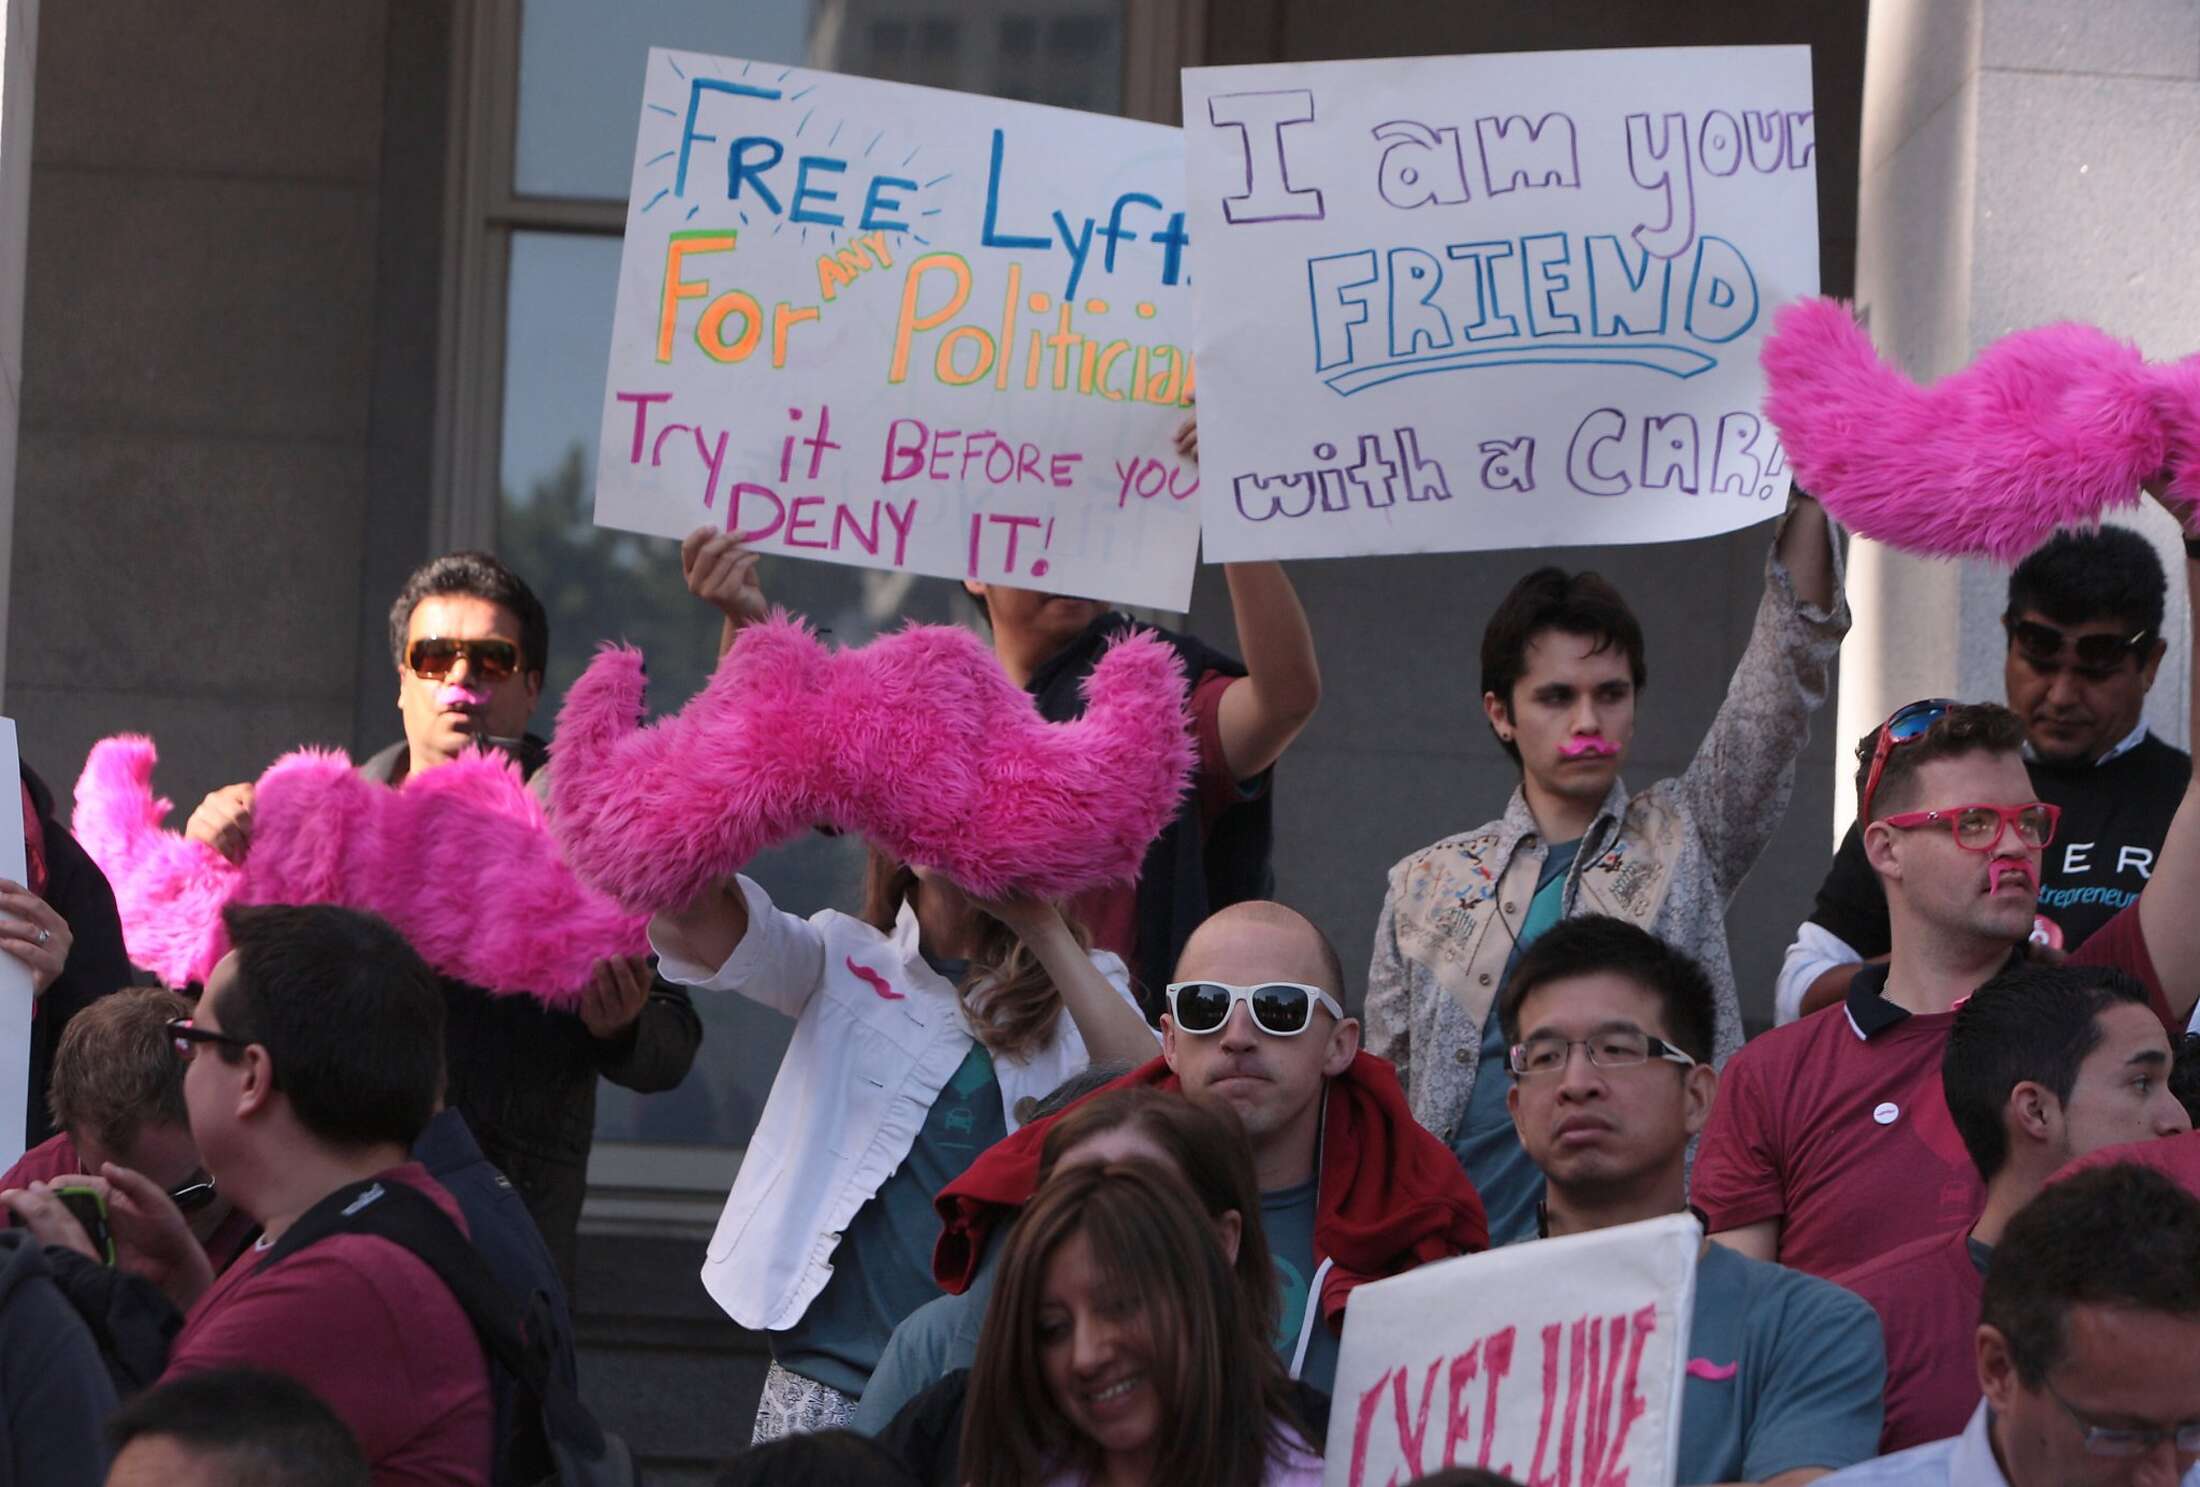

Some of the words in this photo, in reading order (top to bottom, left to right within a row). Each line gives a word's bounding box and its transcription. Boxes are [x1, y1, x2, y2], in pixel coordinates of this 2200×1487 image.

[675, 77, 919, 232] FREE
[981, 128, 1191, 301] Lyft
[1208, 89, 1325, 224] I
[1372, 112, 1581, 211] am
[1625, 109, 1815, 259] your
[655, 229, 821, 369] For
[816, 231, 893, 301] ANY
[1308, 232, 1759, 373] FRIEND
[616, 392, 729, 509] Try
[779, 404, 841, 483] it
[882, 418, 1082, 488] BEFORE
[1233, 427, 1452, 521] with
[1479, 435, 1536, 494] a
[1565, 407, 1787, 502] CAR!
[726, 482, 918, 566] DENY
[967, 512, 1055, 578] IT!
[2037, 884, 2140, 908] trepreneur
